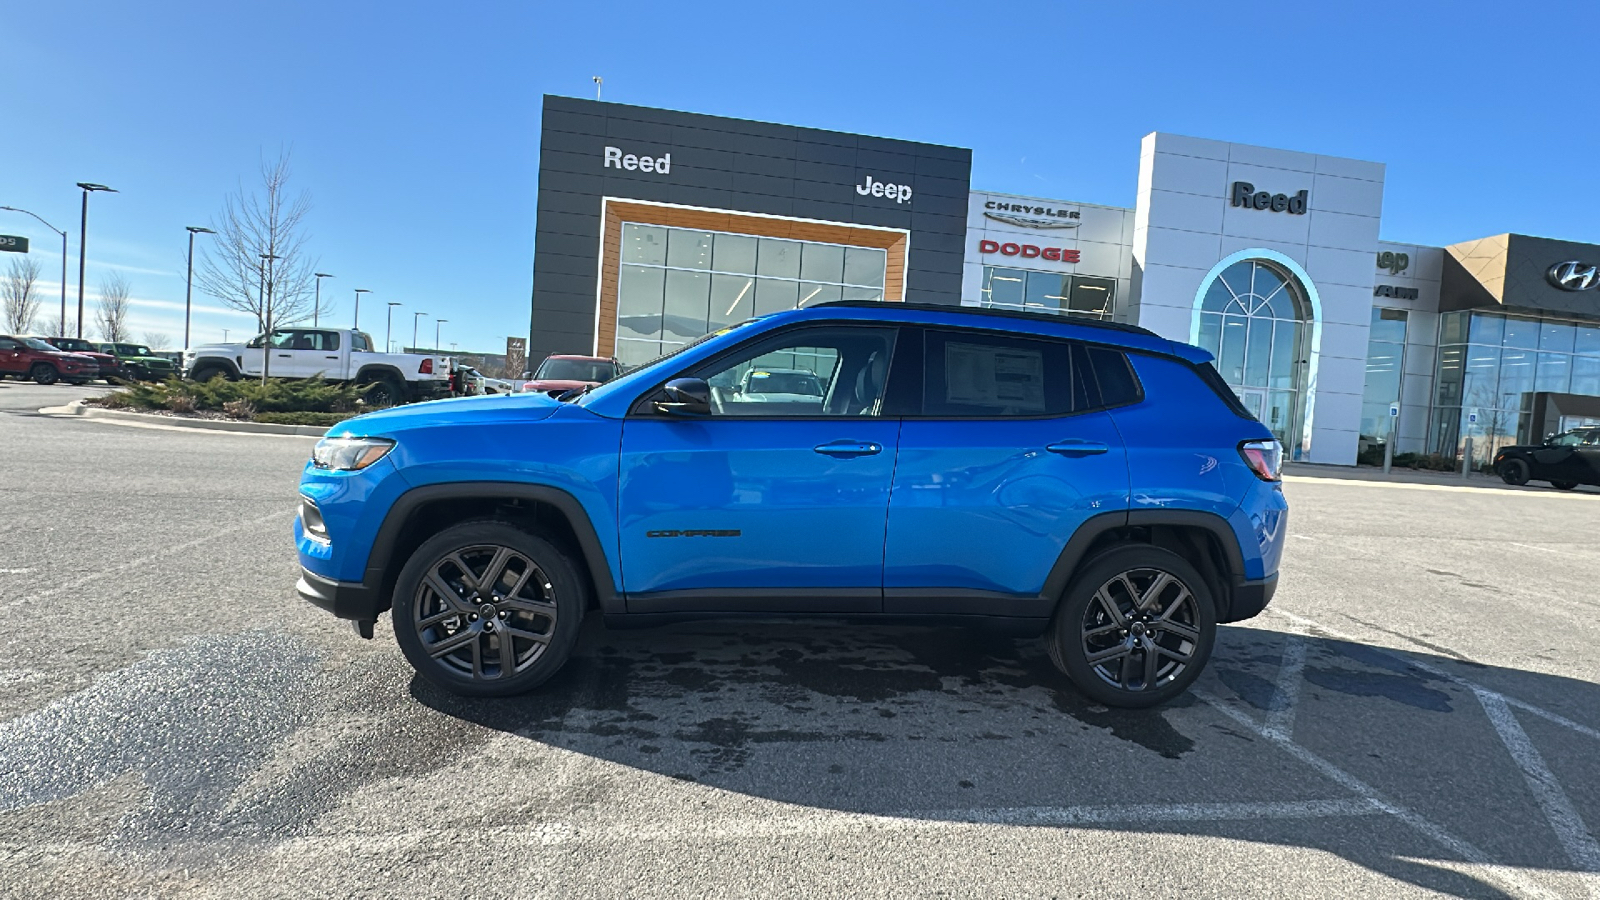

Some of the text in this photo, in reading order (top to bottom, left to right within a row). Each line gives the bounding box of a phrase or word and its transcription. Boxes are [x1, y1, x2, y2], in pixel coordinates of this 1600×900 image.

[604, 146, 671, 174] Reed
[985, 201, 1081, 219] CHRYSLER
[1231, 181, 1309, 215] Reed
[979, 239, 1081, 263] DODGE
[1373, 284, 1419, 300] AM
